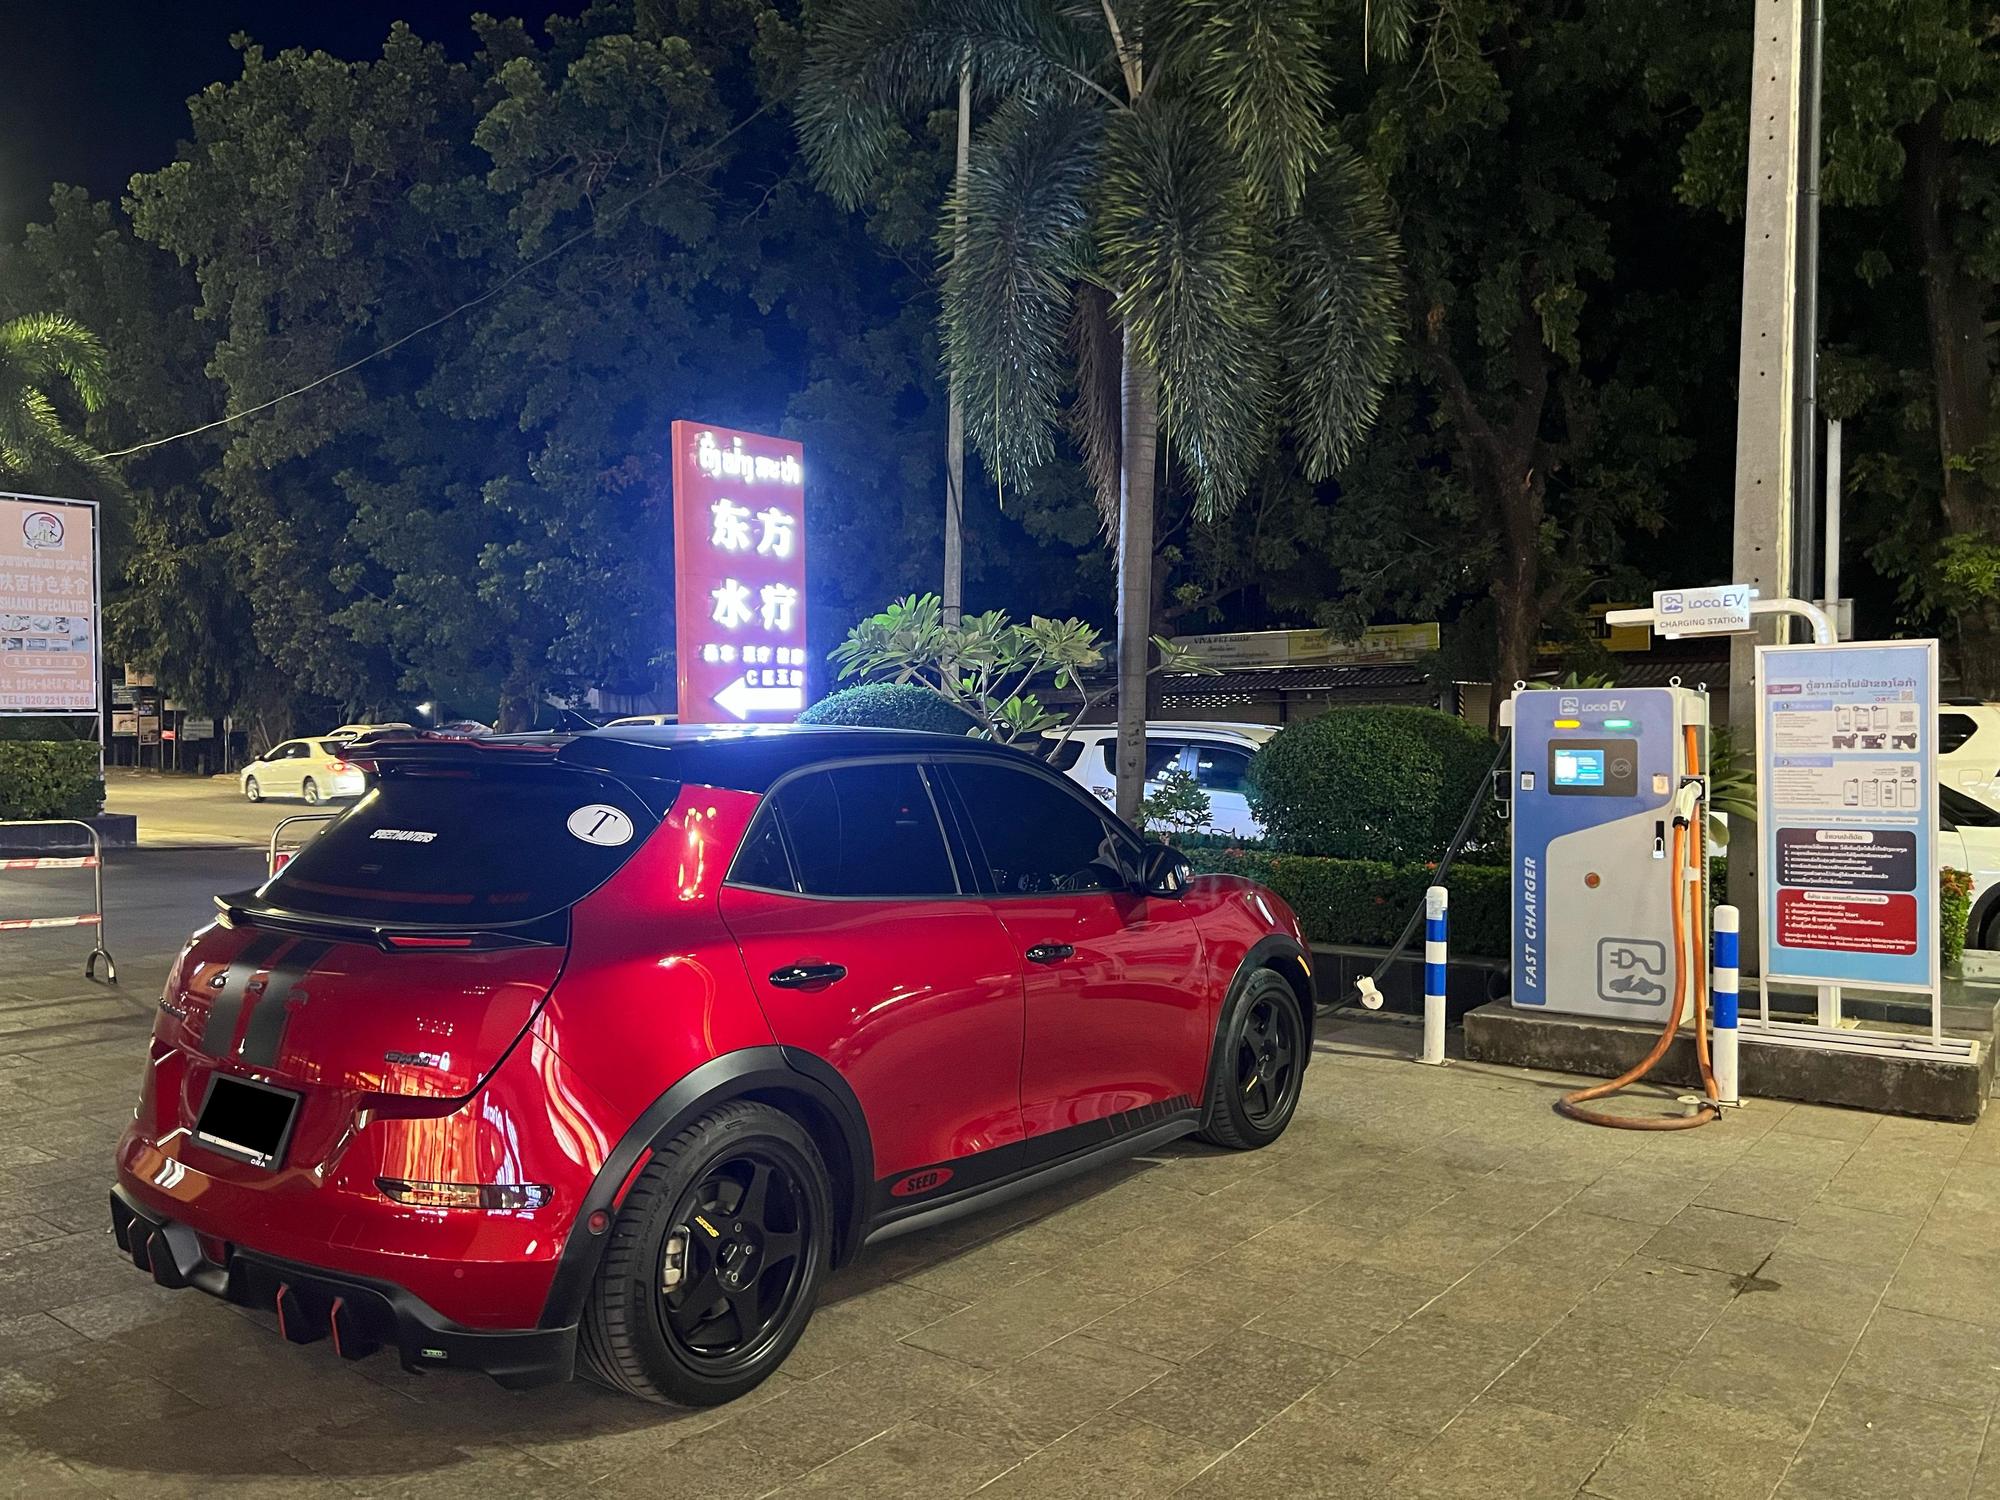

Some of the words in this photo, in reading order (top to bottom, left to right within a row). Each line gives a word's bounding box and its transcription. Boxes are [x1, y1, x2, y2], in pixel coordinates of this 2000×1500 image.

[710, 498, 794, 557] 东方
[38, 598, 89, 614] SPECIALTIES
[711, 578, 798, 631] 水疗
[1723, 593, 1744, 607] EV
[1660, 618, 1705, 629] CHARGING
[1707, 615, 1744, 625] STATION
[25, 695, 42, 705] 020
[1609, 700, 1627, 711] EV
[584, 809, 619, 838] T
[369, 829, 438, 843] SPEEDHUNTERS
[1525, 856, 1537, 941] CHARGER
[1525, 943, 1537, 988] FAST
[250, 1158, 266, 1168] ORA
[907, 1172, 937, 1192] SEED
